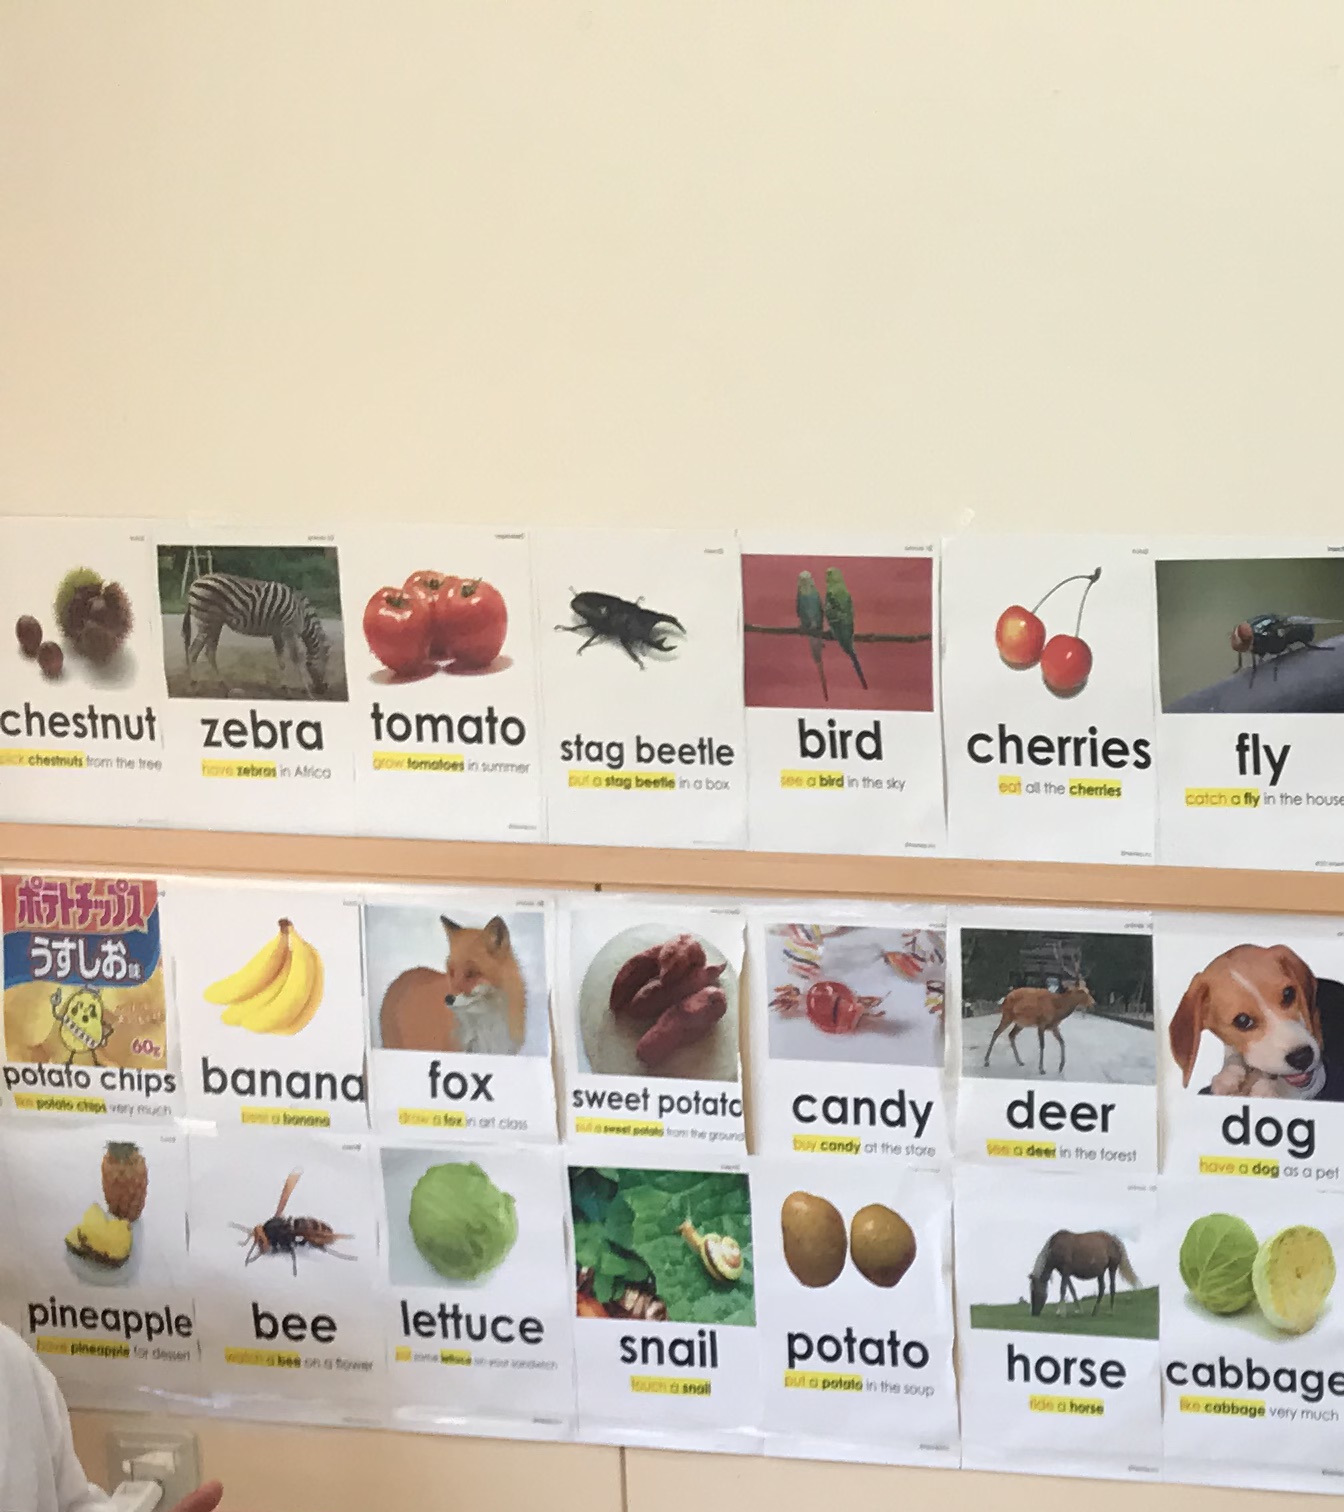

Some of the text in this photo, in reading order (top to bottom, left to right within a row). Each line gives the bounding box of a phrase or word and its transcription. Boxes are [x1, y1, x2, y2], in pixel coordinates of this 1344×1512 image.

[0, 702, 156, 741] chestnut
[201, 709, 323, 751] zebra
[371, 702, 526, 746] tomato
[798, 718, 883, 760] bird
[406, 757, 464, 772] tomatoes
[467, 759, 479, 772] in
[481, 762, 531, 774] summer
[561, 734, 734, 770] stag beetle
[967, 723, 1151, 769] cherries
[1236, 733, 1291, 786] fly
[592, 776, 602, 787] a
[604, 774, 632, 790] stag
[634, 775, 676, 790] beetle
[678, 776, 690, 789] in
[693, 779, 703, 790] a
[705, 777, 730, 790] box
[806, 777, 816, 788] a
[819, 774, 844, 788] bird
[847, 776, 859, 788] in
[862, 776, 883, 789] the
[886, 777, 906, 792] sky
[1025, 782, 1041, 794] all
[1043, 782, 1065, 795] the
[1069, 783, 1122, 798] cherries
[1230, 795, 1241, 805] a
[1244, 792, 1261, 808] fly
[1263, 792, 1276, 805] in
[1279, 793, 1303, 806] the
[18, 876, 147, 930] ポテトチップス
[3, 1063, 176, 1097] potato chips
[202, 1059, 364, 1101] banana
[429, 1060, 494, 1102] fox
[573, 1087, 743, 1119] sweet potato
[792, 1089, 933, 1138] candy
[1007, 1090, 1116, 1133] deer
[819, 1140, 861, 1155] candy
[864, 1143, 877, 1153] at
[881, 1142, 902, 1155] the
[905, 1144, 936, 1157] store
[1222, 1105, 1315, 1159] dog
[1013, 1146, 1023, 1156] a
[1025, 1144, 1057, 1158] deer
[1059, 1146, 1072, 1158] in
[1075, 1147, 1097, 1160] the
[1100, 1148, 1137, 1162] forest
[1239, 1164, 1248, 1174] a
[1252, 1161, 1280, 1179] dog
[1283, 1166, 1299, 1177] as
[1302, 1168, 1312, 1178] a
[1316, 1167, 1339, 1181] pet
[29, 1296, 192, 1342] pineapple
[252, 1302, 337, 1343] bee
[401, 1300, 544, 1345] lettuce
[620, 1328, 718, 1368] snail
[787, 1327, 929, 1369] potato
[1007, 1343, 1126, 1389] horse
[1205, 1402, 1265, 1419] cabbage
[1269, 1407, 1298, 1421] very
[1301, 1409, 1339, 1422] much
